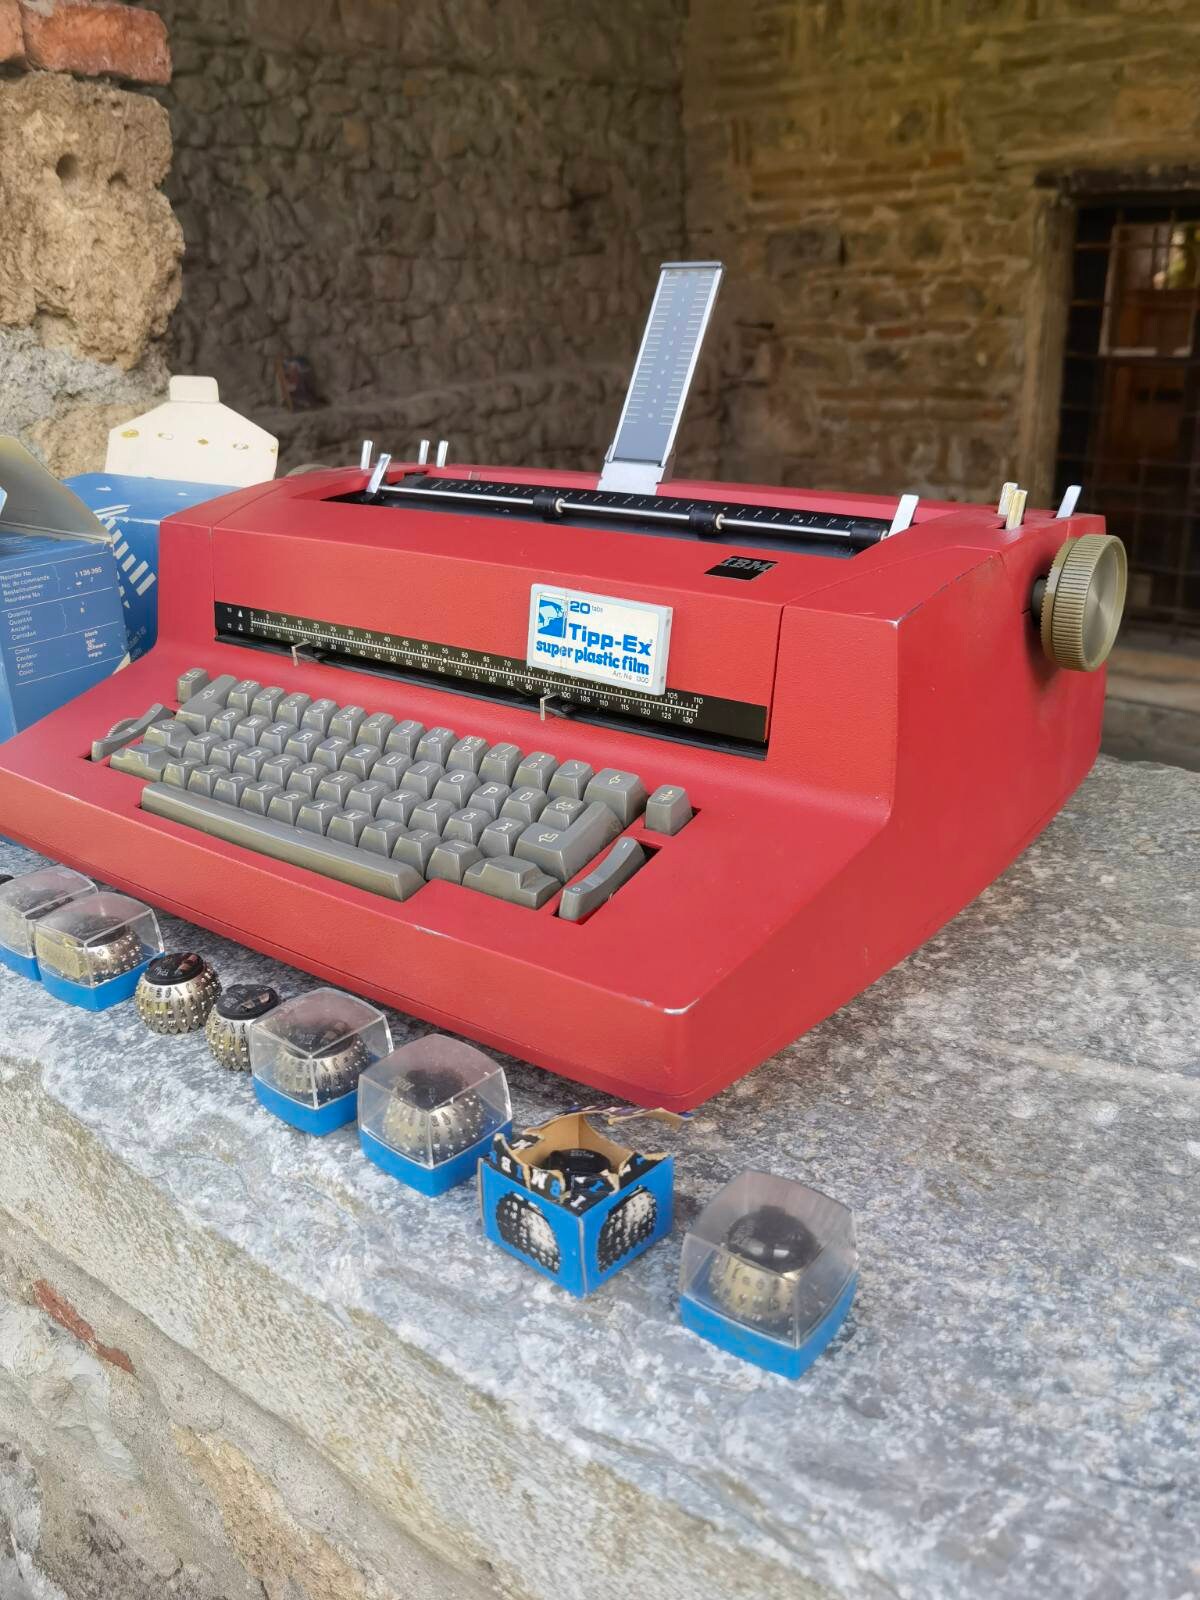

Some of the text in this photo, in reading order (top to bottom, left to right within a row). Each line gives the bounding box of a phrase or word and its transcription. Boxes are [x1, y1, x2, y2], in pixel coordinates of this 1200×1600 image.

[724, 557, 773, 571] IBM
[570, 600, 591, 614] 20
[568, 622, 652, 656] Tipp-Ex
[536, 640, 650, 676] super plastic film
[504, 659, 512, 667] 70
[667, 692, 678, 700] 105
[693, 696, 704, 704] 110
[561, 691, 571, 699] 100
[580, 695, 591, 703] 105
[640, 708, 651, 716] 120
[661, 712, 672, 720] 125
[222, 711, 236, 720] Q
[272, 725, 288, 734] E
[297, 732, 313, 740] R
[329, 740, 343, 749] T
[355, 748, 371, 757] Z
[386, 756, 402, 765] U
[450, 774, 465, 783] O
[482, 786, 498, 795] P
[393, 793, 410, 801] K
[426, 802, 438, 811] L
